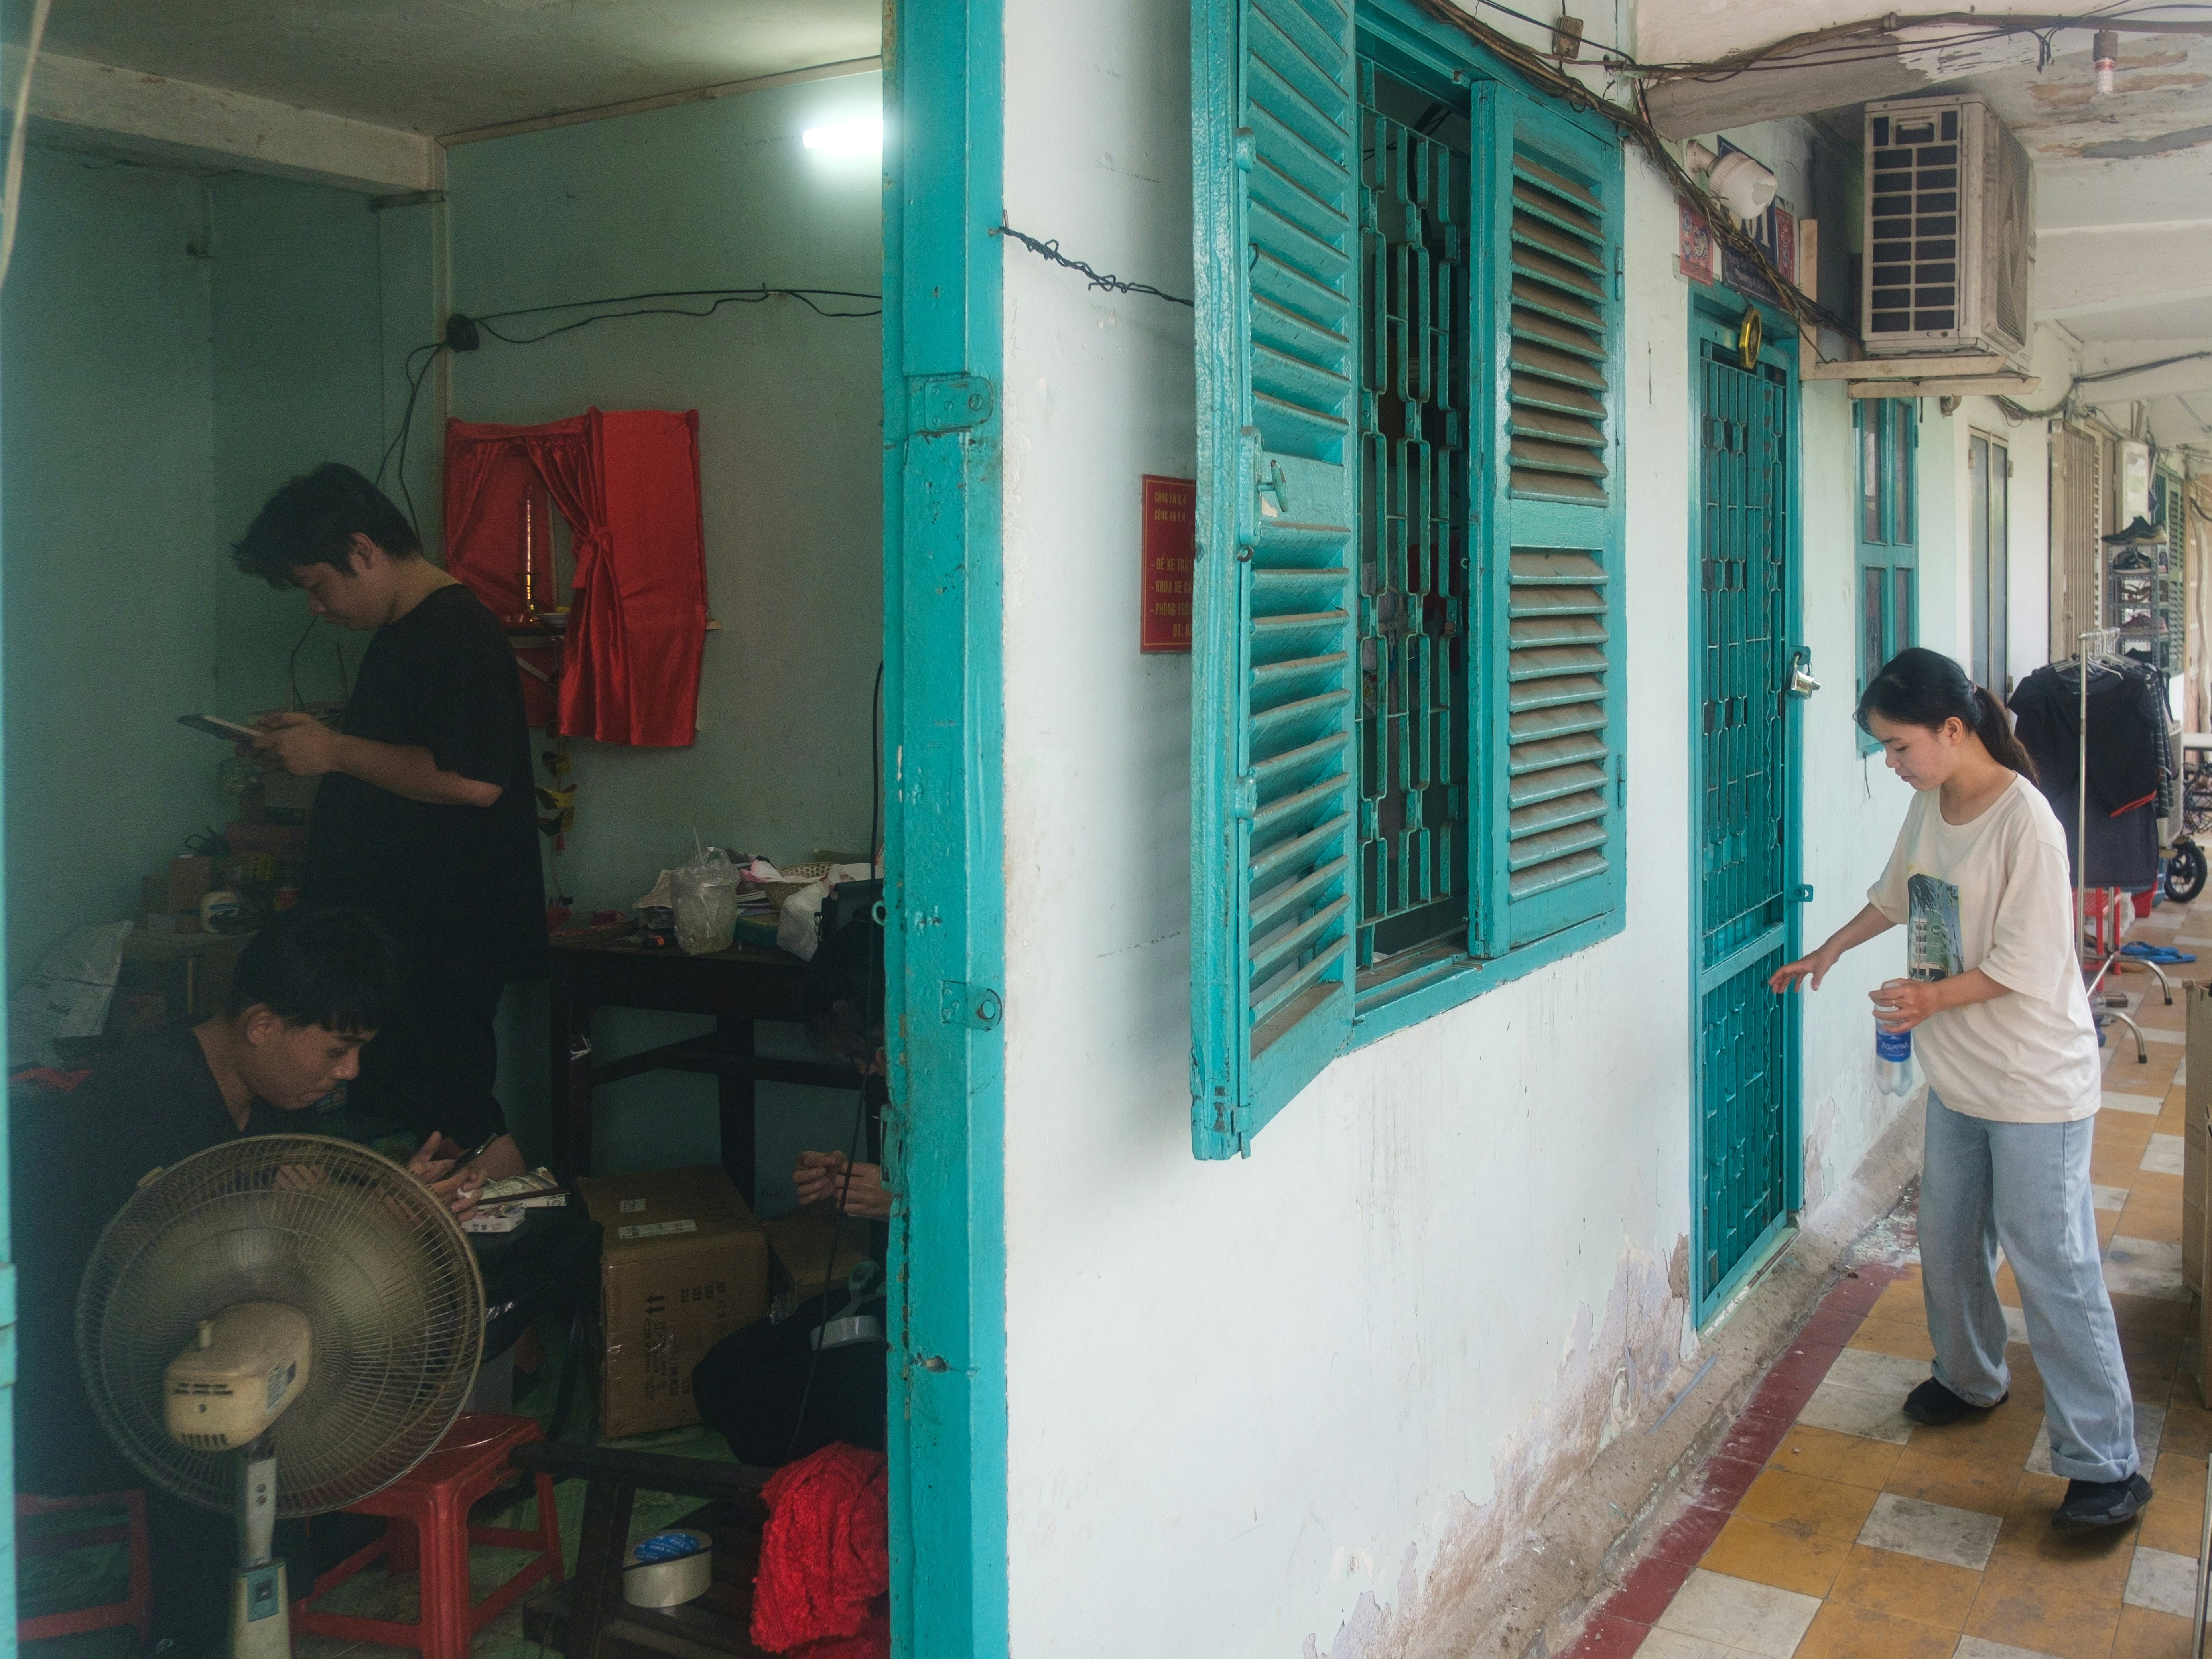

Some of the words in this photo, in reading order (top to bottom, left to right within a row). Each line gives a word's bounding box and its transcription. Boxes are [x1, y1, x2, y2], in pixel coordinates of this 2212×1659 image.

[1155, 490, 1168, 503] CÔNG
[1169, 493, 1176, 504] AN
[1155, 508, 1168, 521] CÔNG
[1169, 511, 1176, 522] AN
[1156, 552, 1165, 570] ĐỂ
[1167, 558, 1175, 571] XE
[1156, 578, 1172, 593] KHÓA
[1175, 581, 1182, 593] XE
[1155, 600, 1176, 615] PHÒNG
[680, 1288, 689, 1303] PCS
